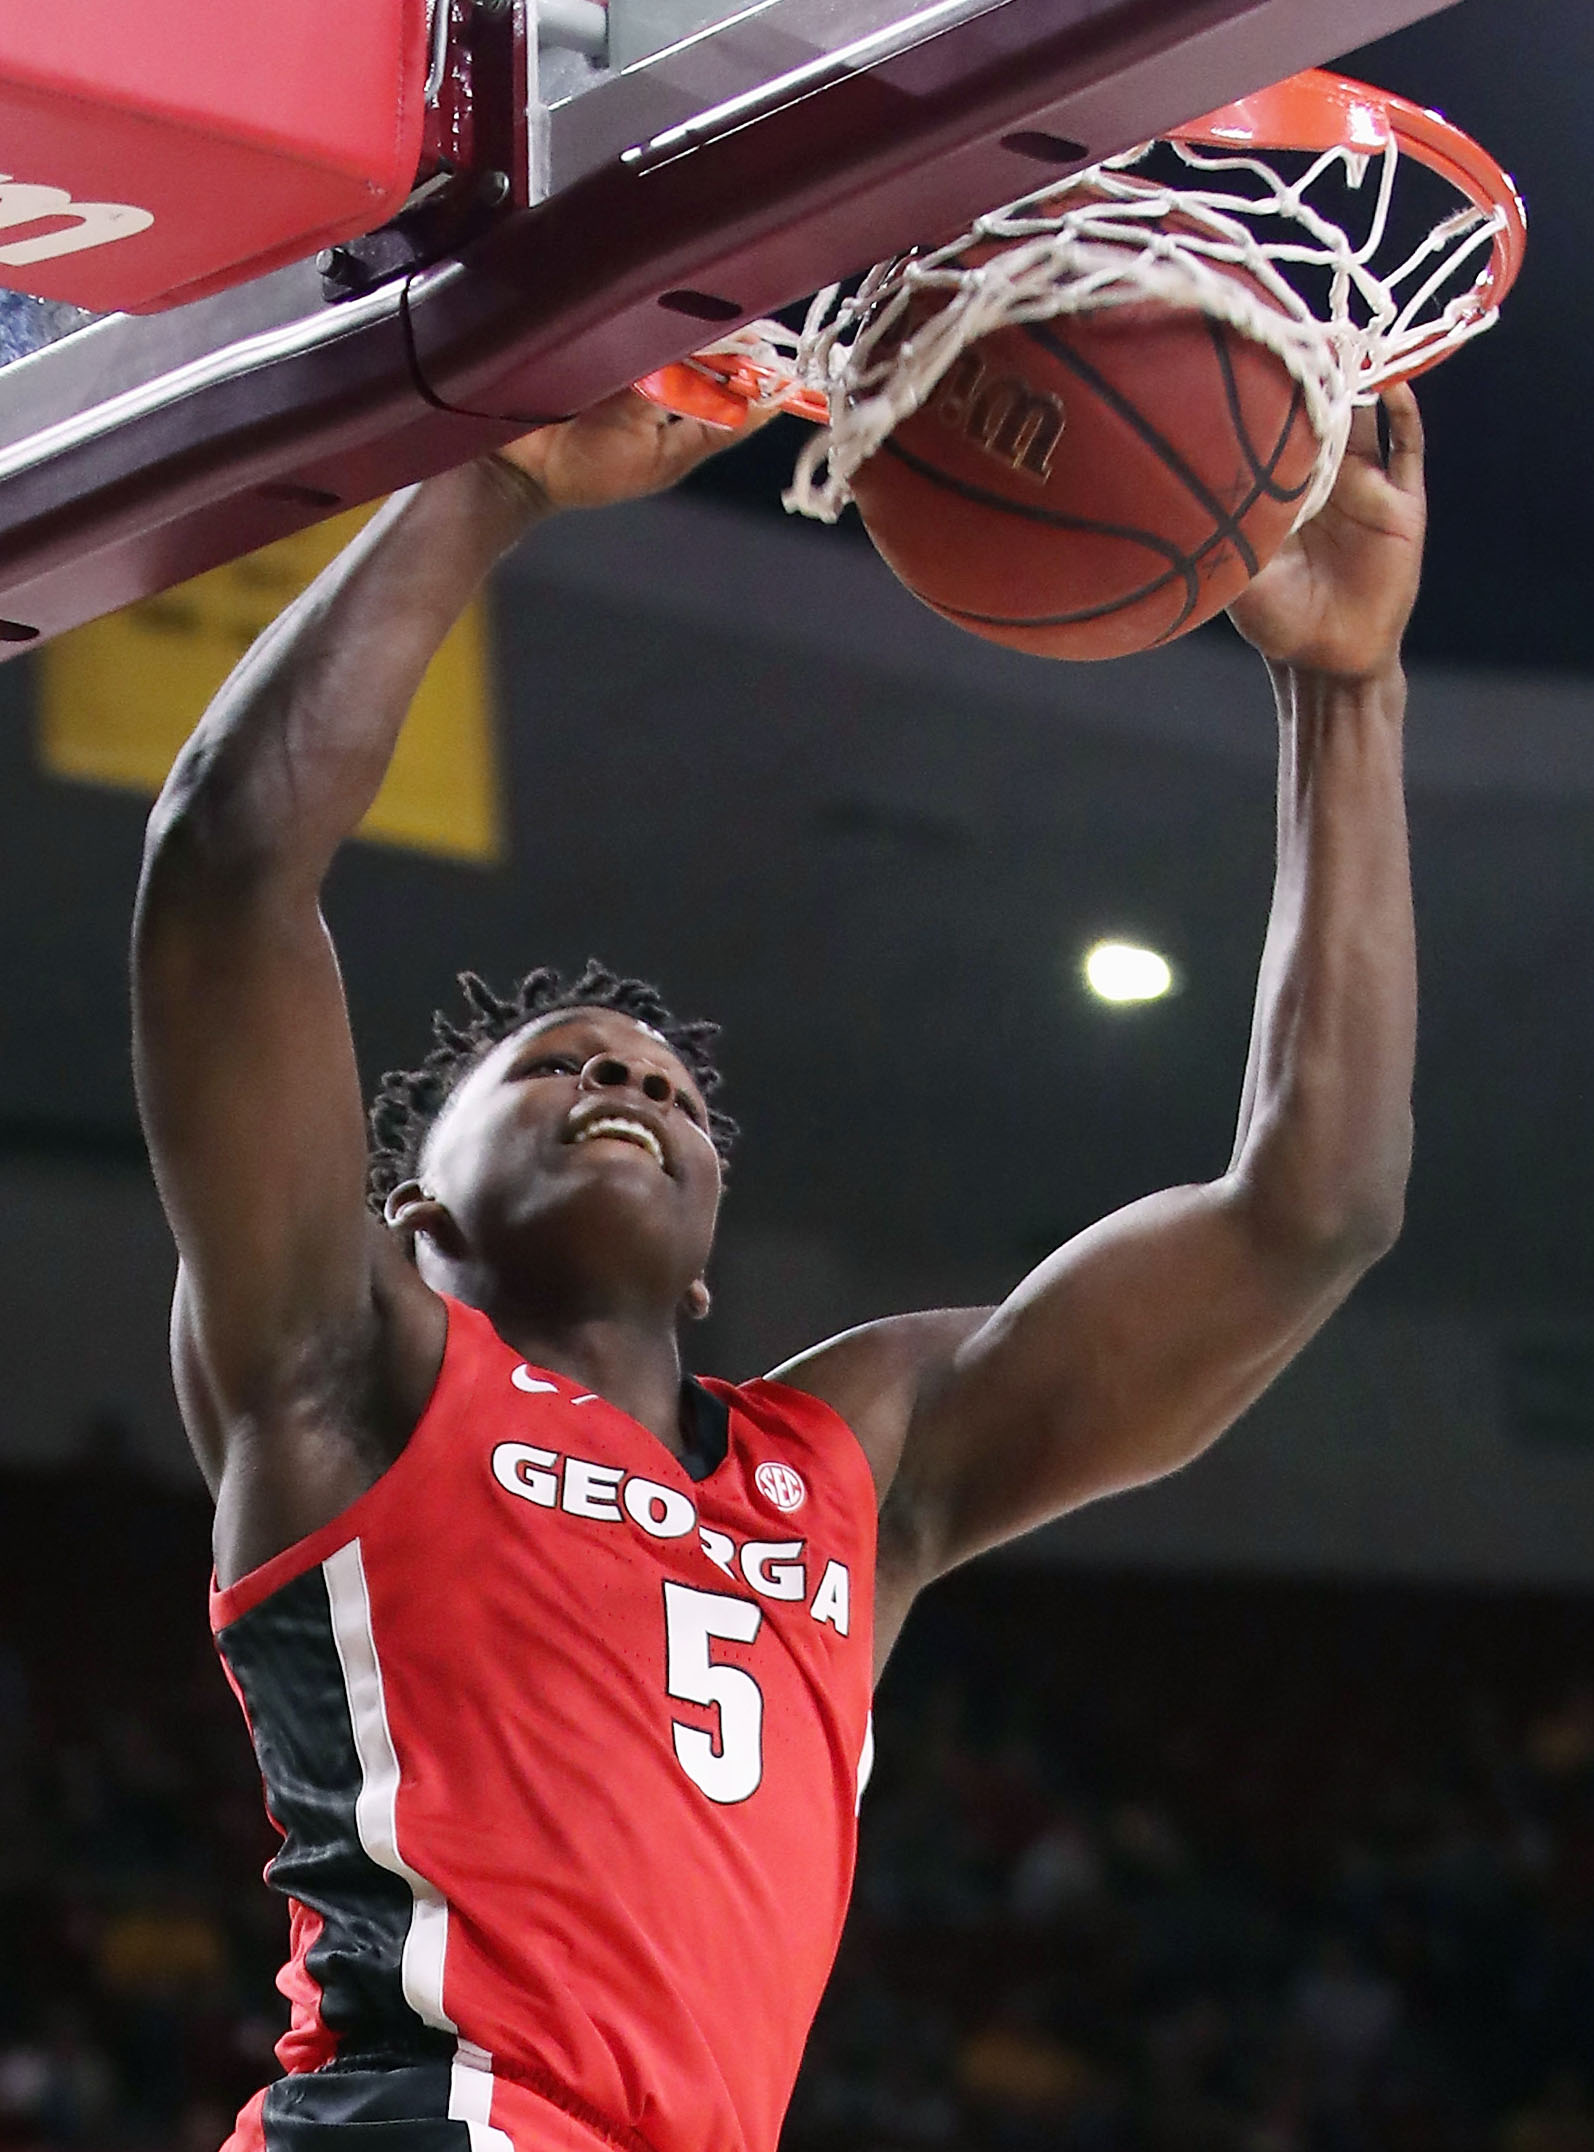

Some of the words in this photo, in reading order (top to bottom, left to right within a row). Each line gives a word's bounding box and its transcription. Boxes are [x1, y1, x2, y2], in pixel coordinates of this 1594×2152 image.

[491, 1441, 850, 1638] GEORGA
[757, 1464, 803, 1509] SEC
[664, 1579, 764, 1804] 5
